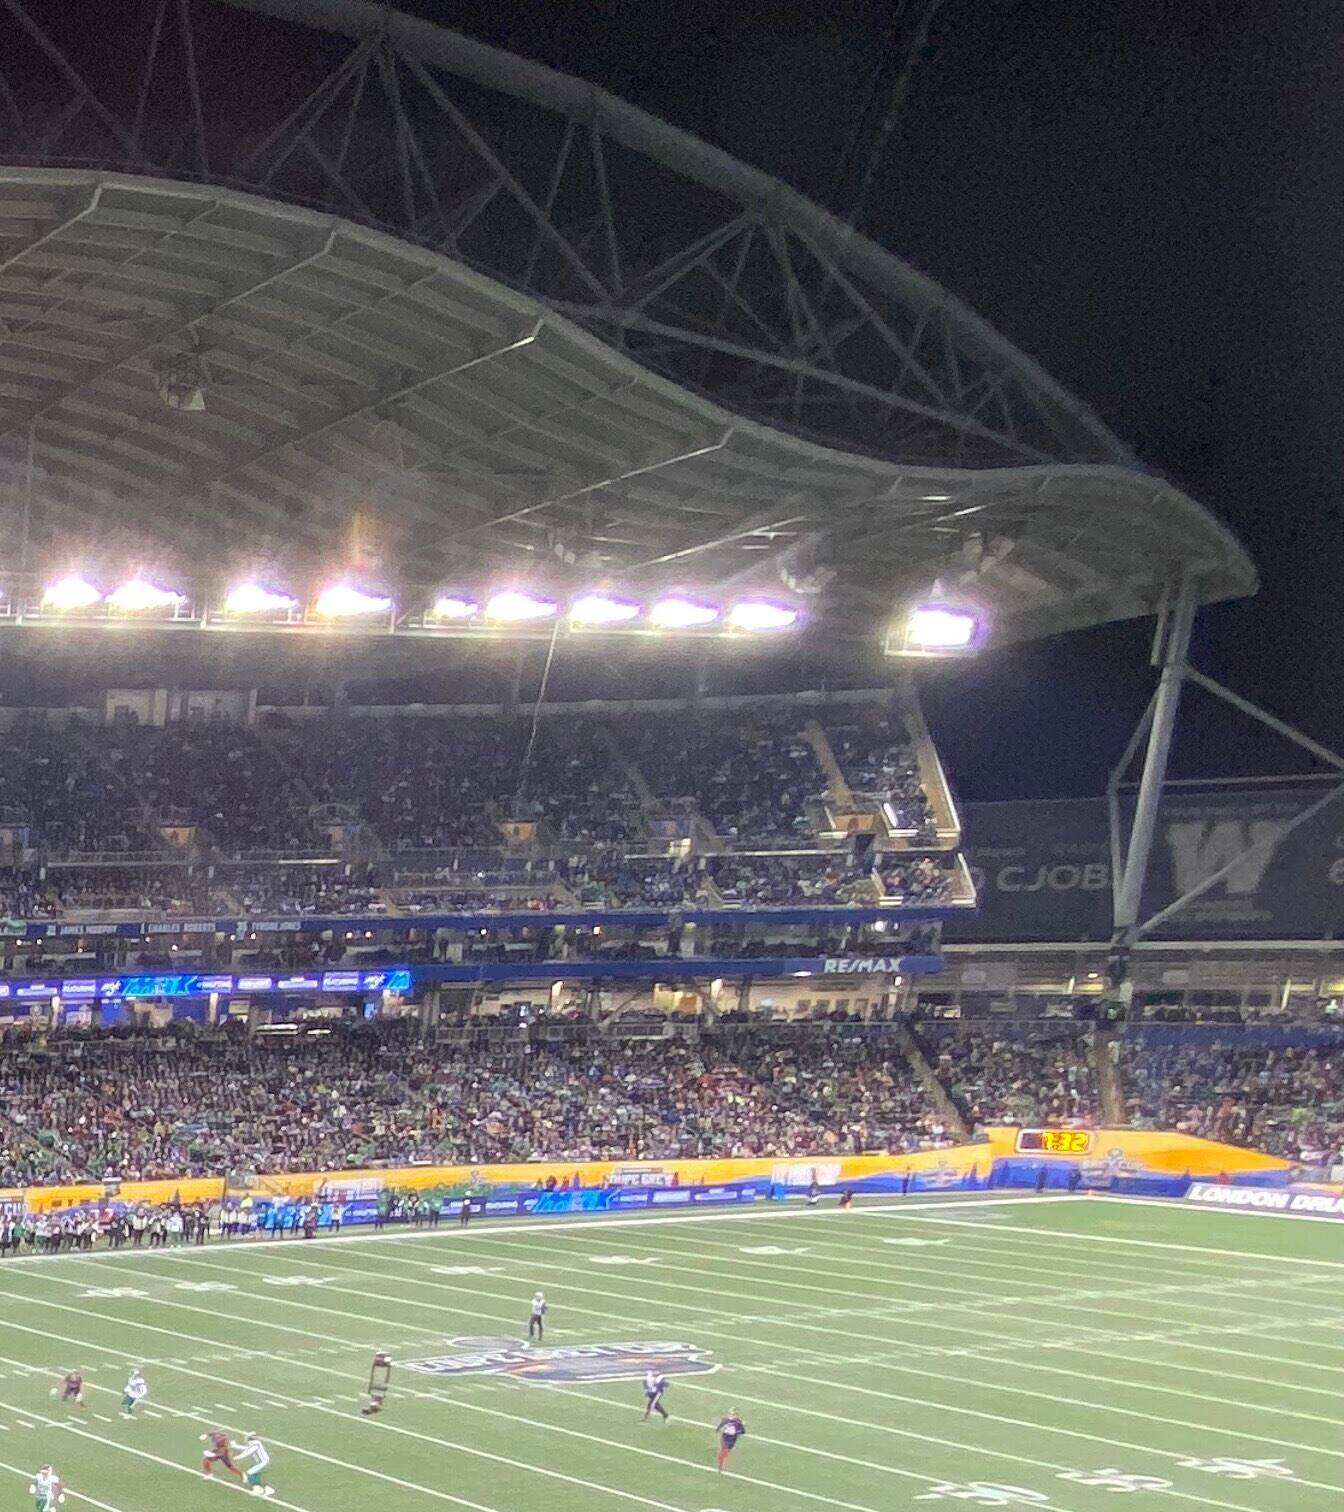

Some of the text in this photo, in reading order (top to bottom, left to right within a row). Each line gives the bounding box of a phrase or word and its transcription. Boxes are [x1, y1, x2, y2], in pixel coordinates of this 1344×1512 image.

[996, 863, 1111, 893] CJOB
[823, 958, 903, 974] RE/MAX
[1188, 1186, 1290, 1209] LONDON
